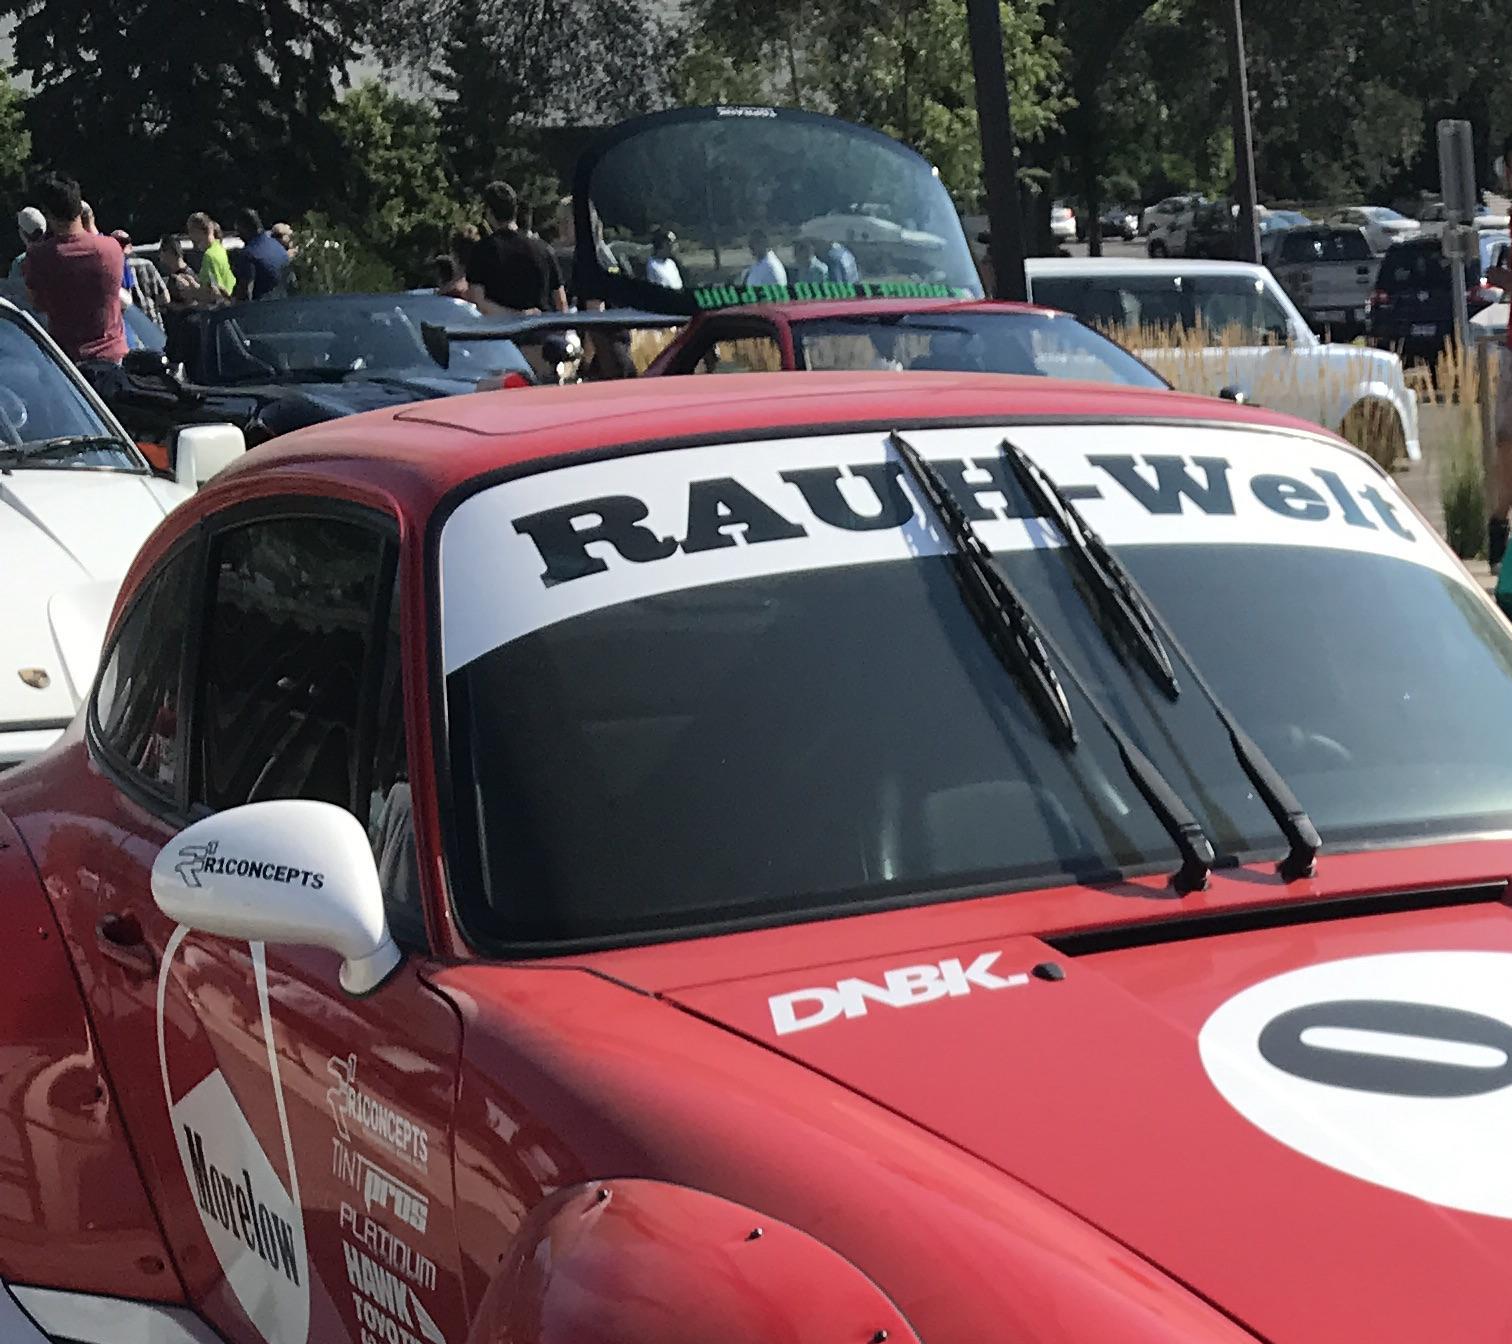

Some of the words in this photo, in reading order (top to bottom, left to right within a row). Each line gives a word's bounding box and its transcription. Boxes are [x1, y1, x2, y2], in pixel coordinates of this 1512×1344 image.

[203, 856, 326, 890] R1CONCEPTS
[183, 1123, 301, 1288] Morelow
[342, 1240, 415, 1330] HAWK
